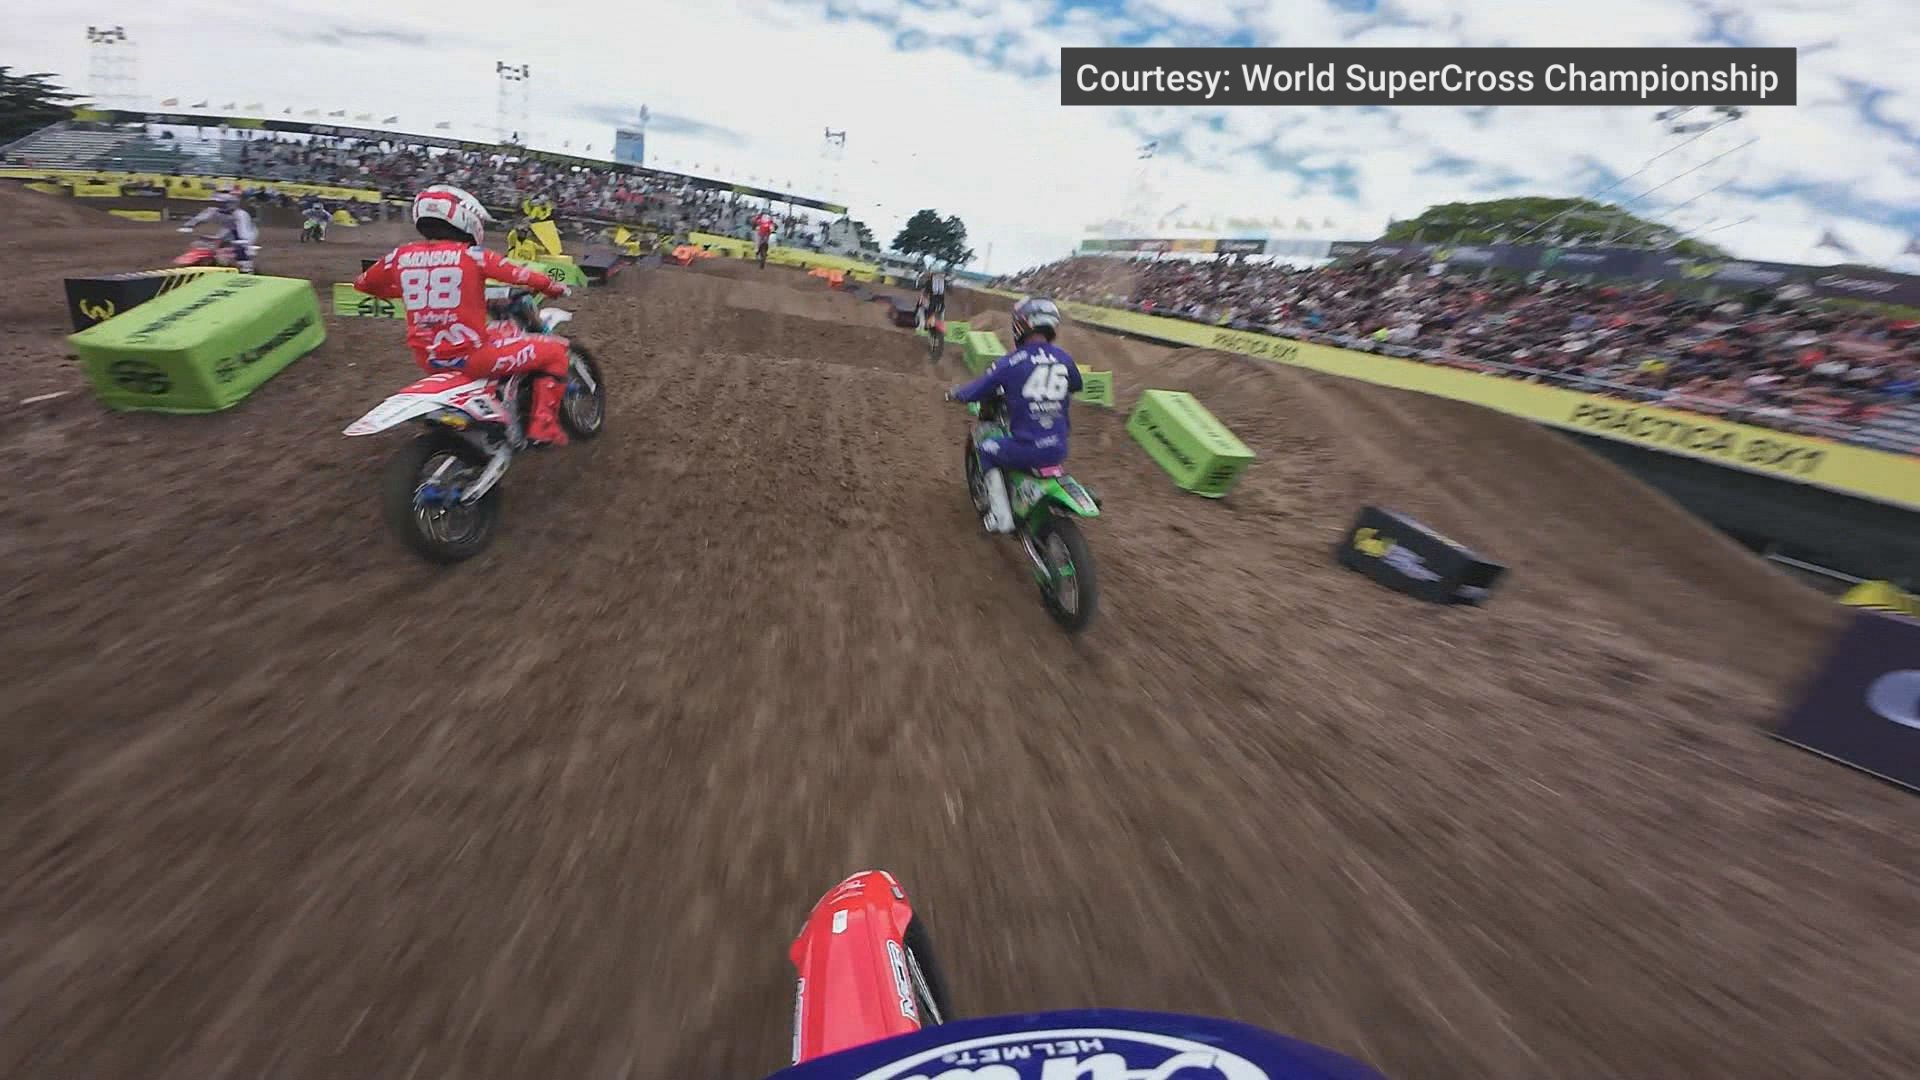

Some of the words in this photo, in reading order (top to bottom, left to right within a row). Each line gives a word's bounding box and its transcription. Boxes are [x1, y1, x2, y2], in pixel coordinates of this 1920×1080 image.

[400, 266, 463, 310] 88
[1021, 363, 1070, 402] 46
[950, 1037, 1105, 1067] HELMET
